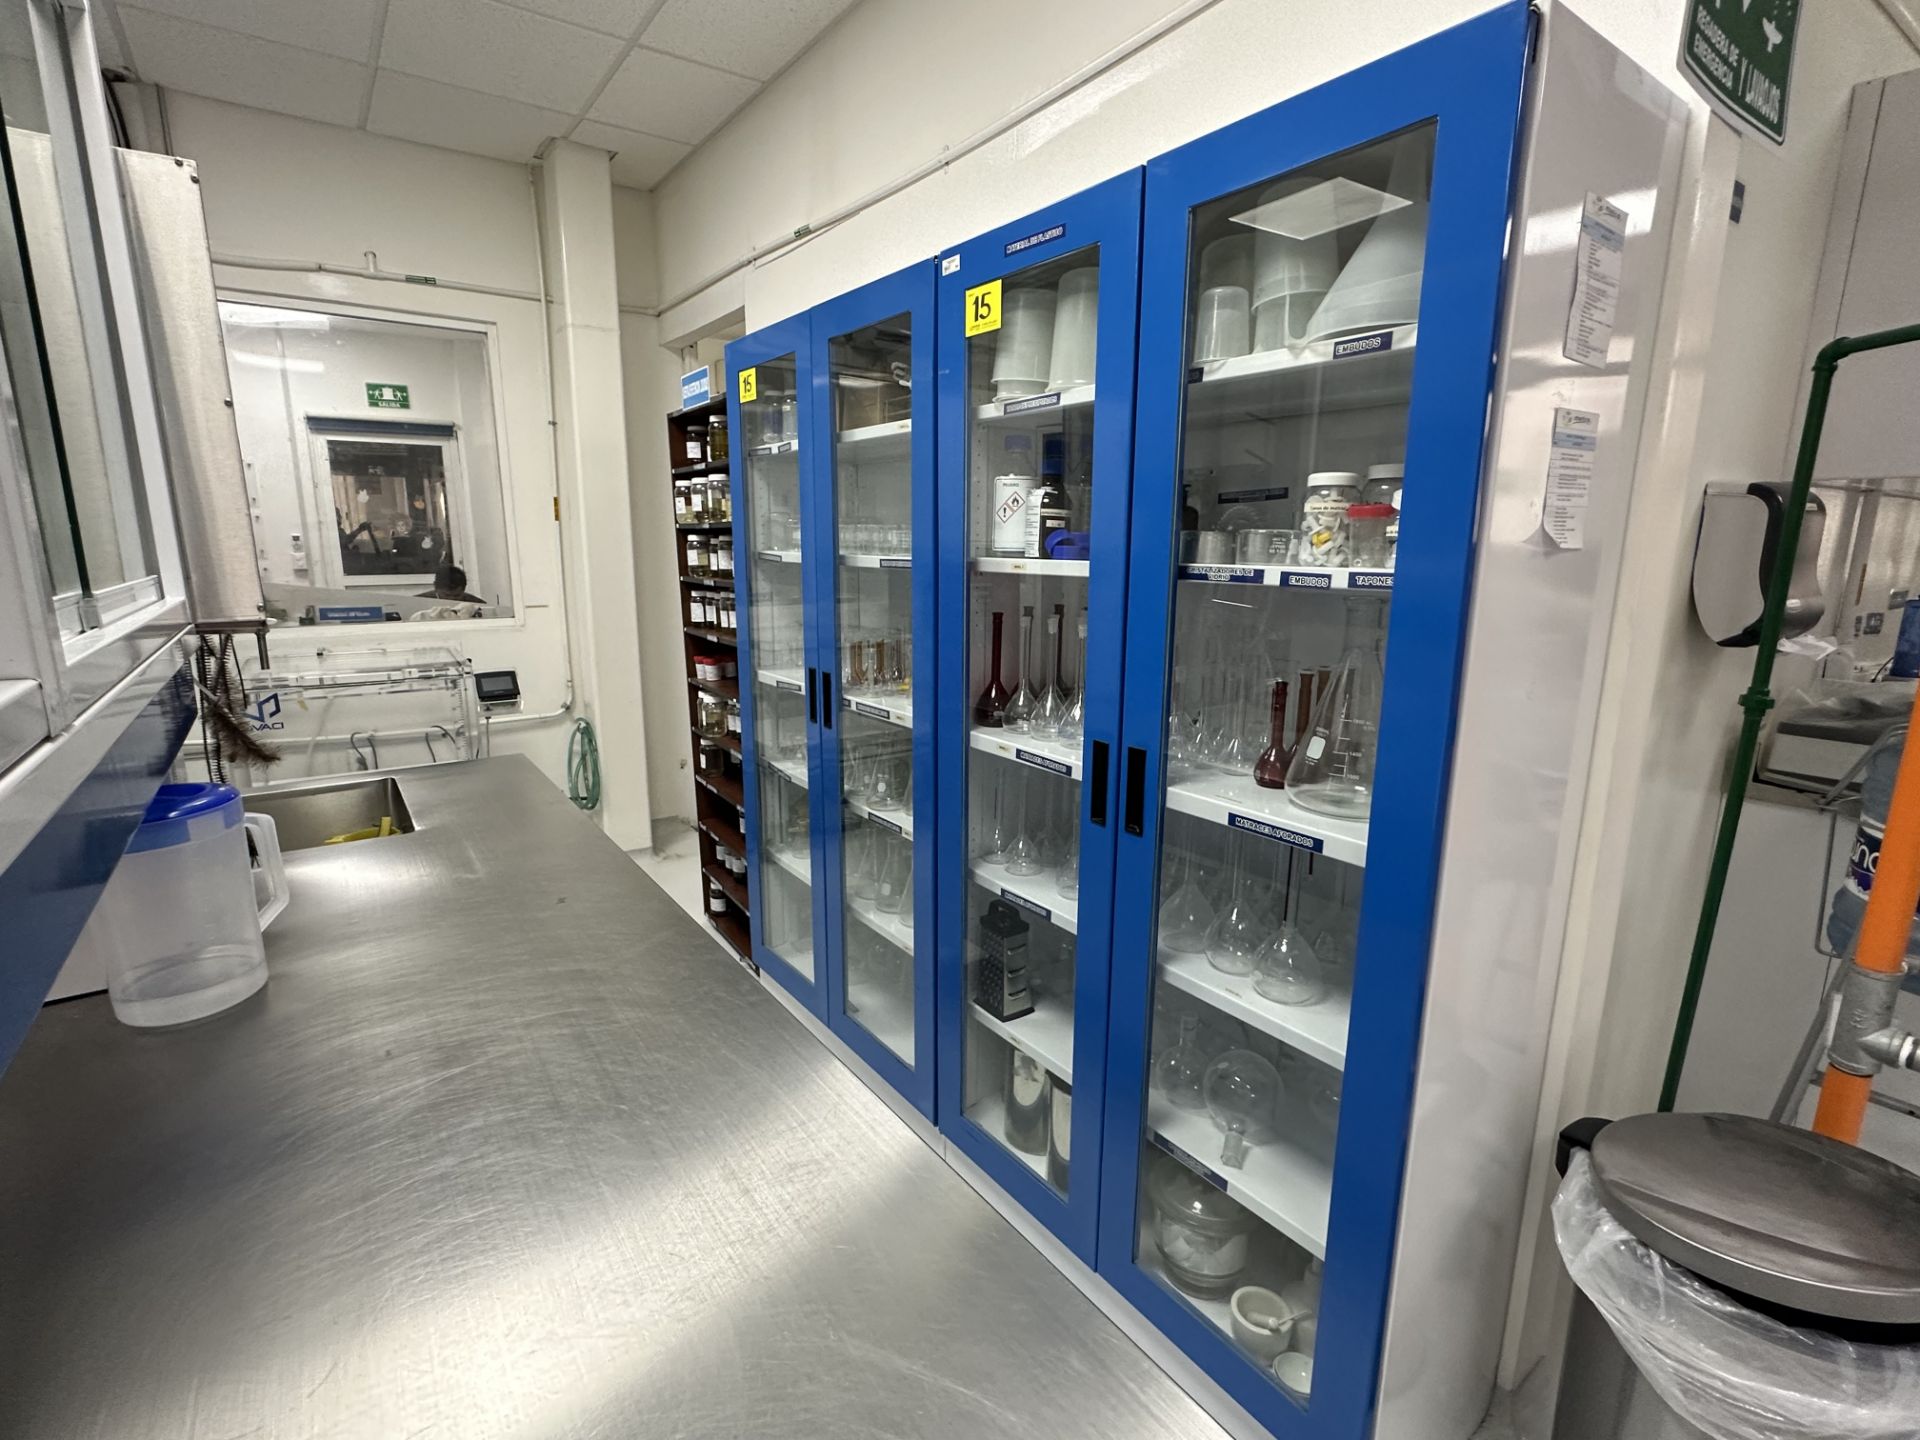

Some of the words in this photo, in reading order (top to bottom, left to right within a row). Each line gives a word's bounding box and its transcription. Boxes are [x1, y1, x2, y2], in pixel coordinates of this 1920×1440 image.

[972, 291, 991, 322] 15
[1335, 337, 1381, 355] EMBUDOS
[743, 374, 752, 394] 15
[1288, 576, 1328, 587] EMBUDOS
[1235, 817, 1272, 835] MATRACES
[1271, 828, 1313, 847] AFORADOS
